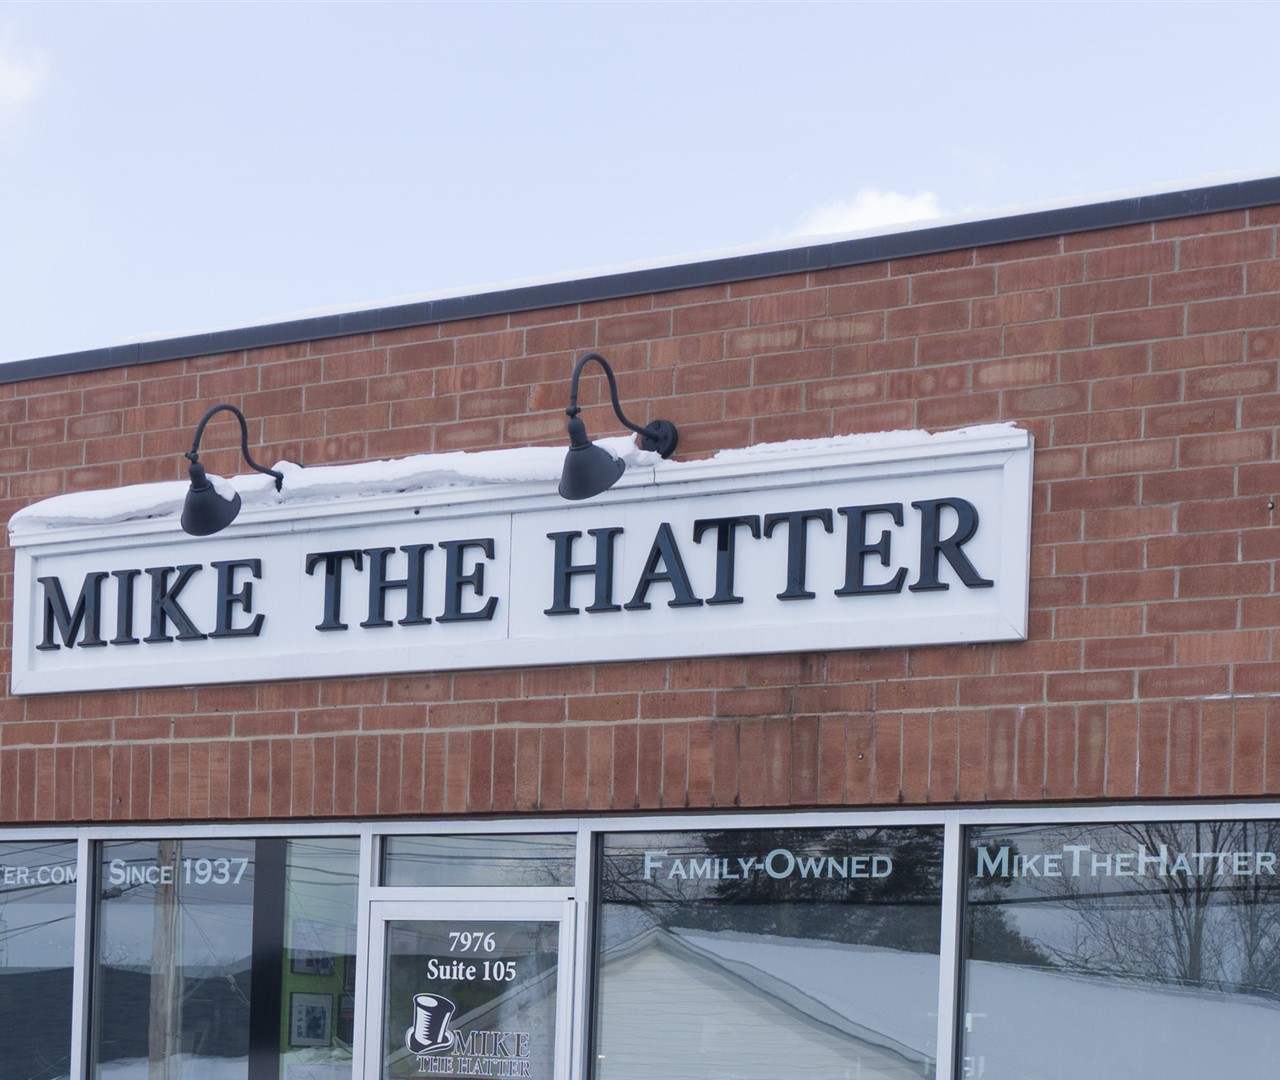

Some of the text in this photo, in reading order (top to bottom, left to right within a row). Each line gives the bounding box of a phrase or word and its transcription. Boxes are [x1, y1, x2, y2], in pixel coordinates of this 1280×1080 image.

[37, 496, 995, 651] MIKE THE HATTER
[109, 857, 249, 884] SINCE 1937
[449, 932, 496, 952] 7976
[427, 959, 517, 981] Suite 105
[451, 1030, 531, 1058] MIKE
[417, 1055, 531, 1078] THE HATTER
